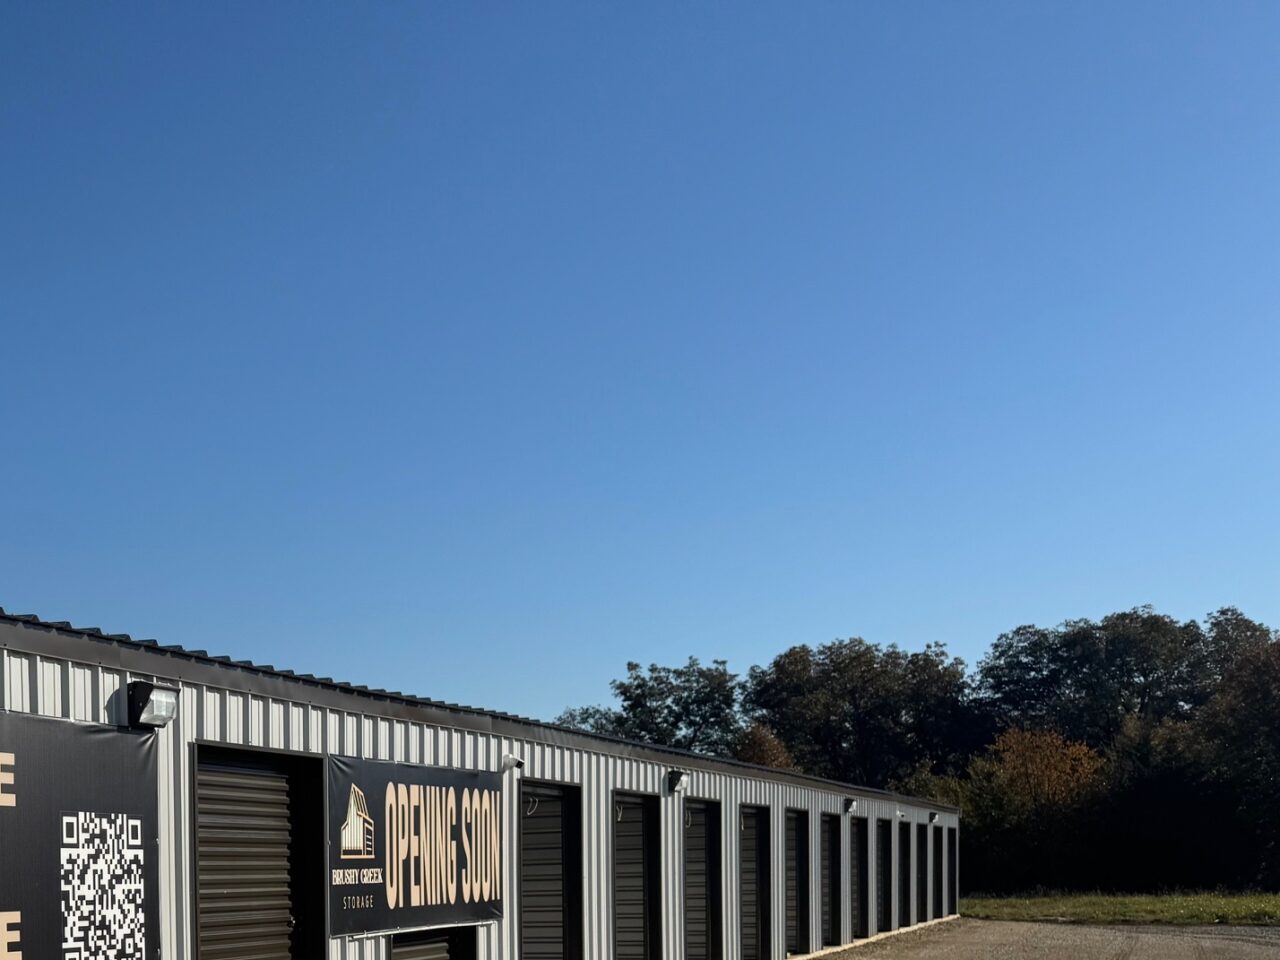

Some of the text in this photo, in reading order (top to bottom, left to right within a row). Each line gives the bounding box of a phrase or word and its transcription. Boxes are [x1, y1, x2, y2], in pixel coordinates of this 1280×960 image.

[385, 781, 500, 910] OPENING SOON
[332, 868, 383, 885] BRUSHY CREEK
[343, 895, 374, 909] STORAGE
